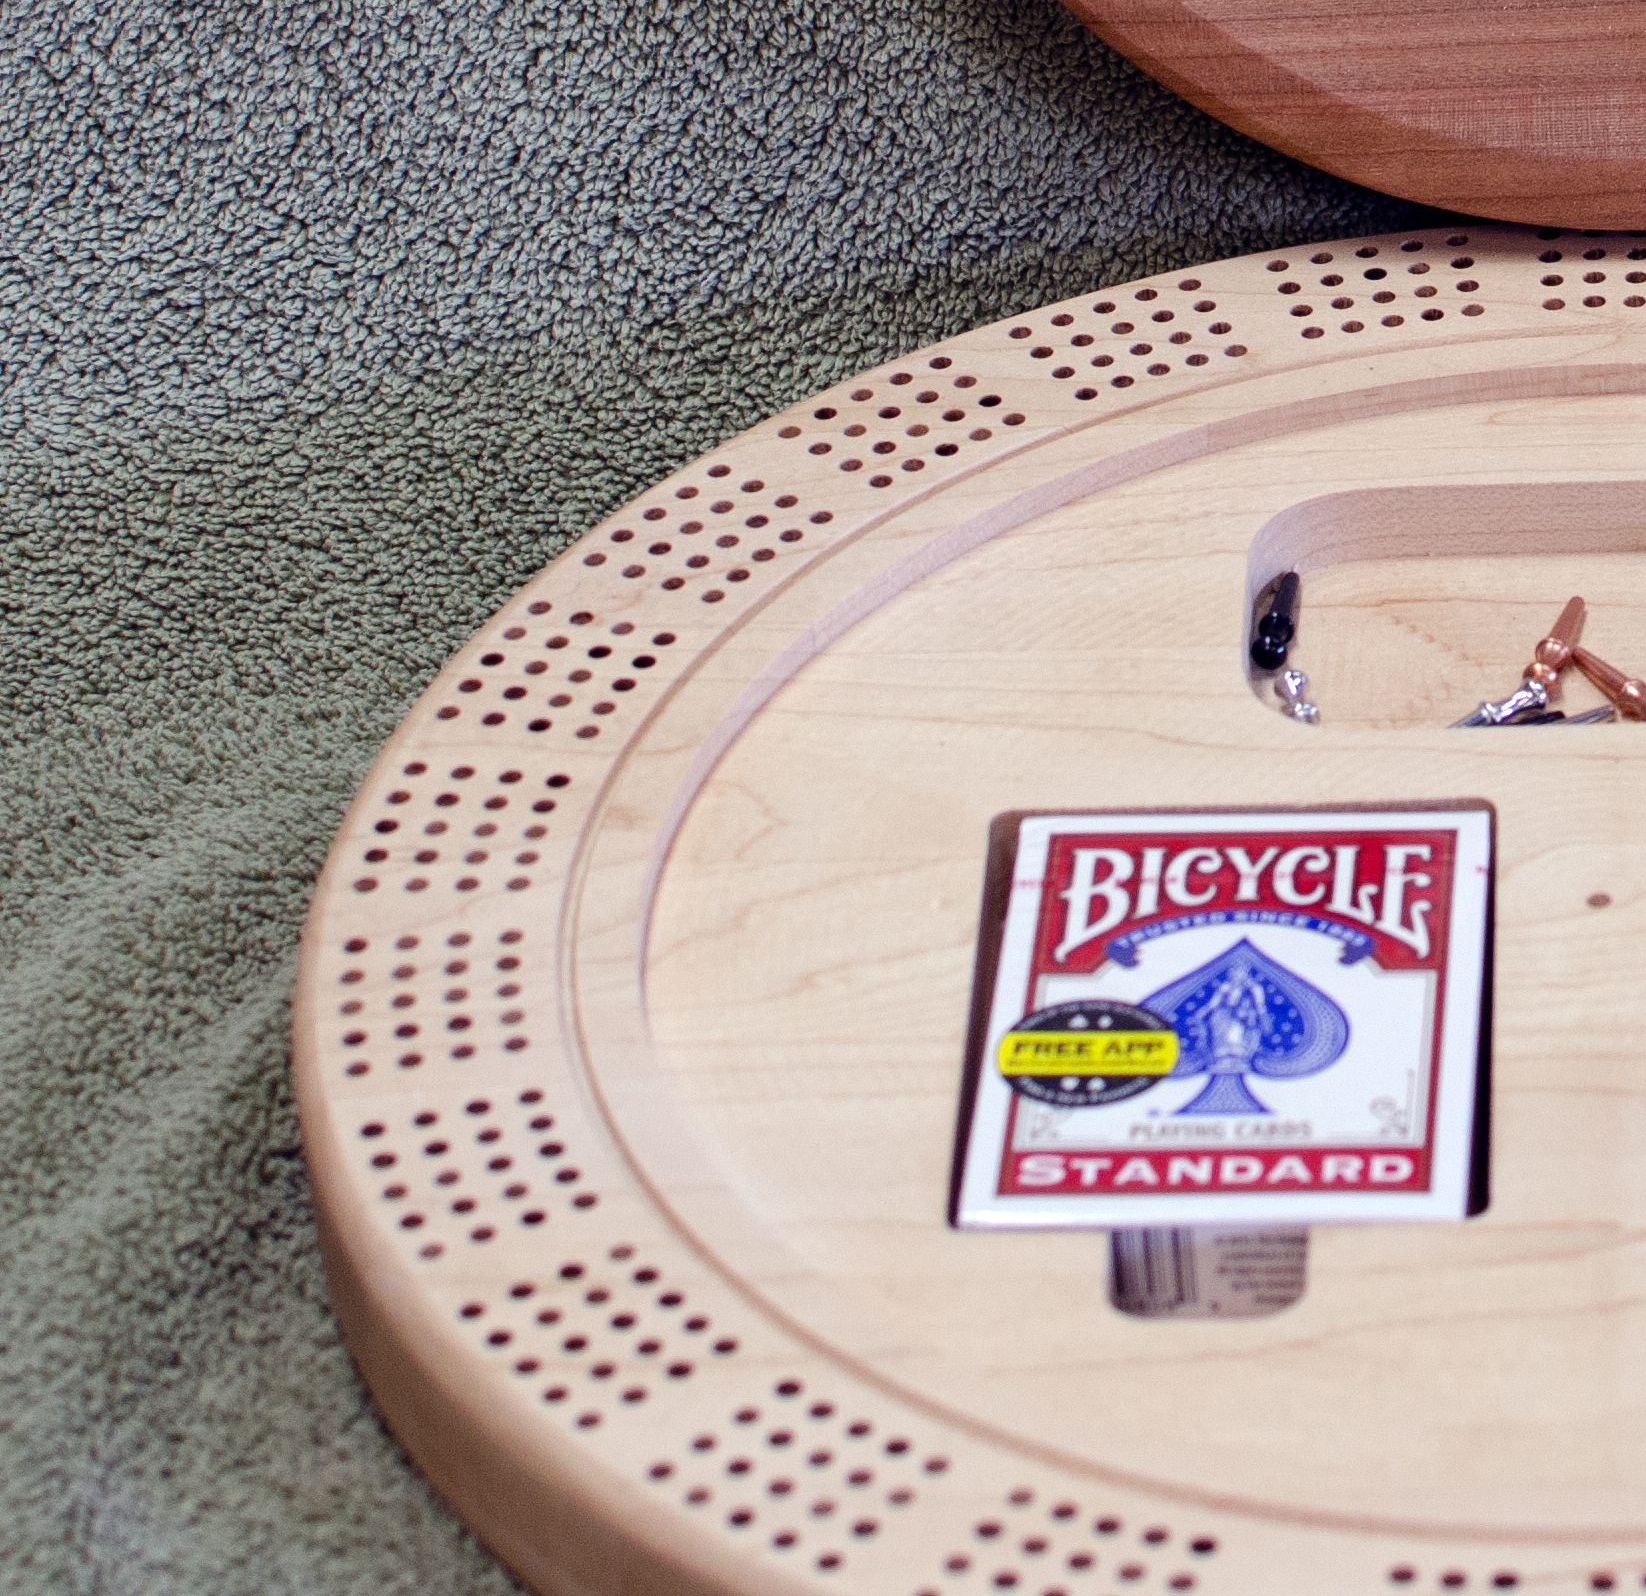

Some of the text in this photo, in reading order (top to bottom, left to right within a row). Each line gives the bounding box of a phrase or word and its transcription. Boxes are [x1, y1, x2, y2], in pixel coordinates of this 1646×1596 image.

[1055, 845, 1431, 962] BICYCLE
[1231, 909, 1310, 927] SINCE
[1013, 1040, 1165, 1057] FREE APP
[1128, 1120, 1314, 1142] PLAYING CARDS
[1016, 1155, 1415, 1186] STANDARD
